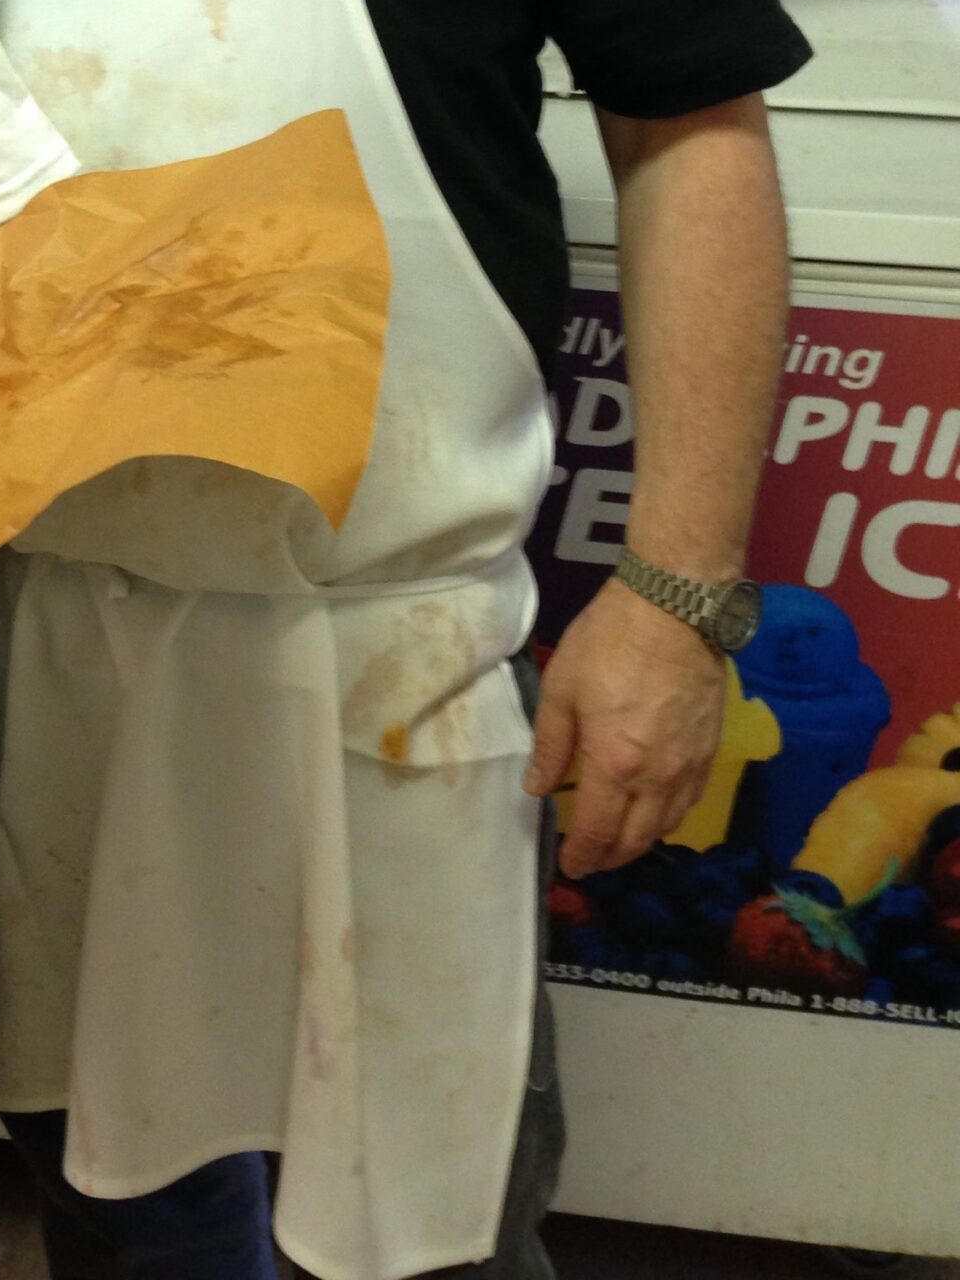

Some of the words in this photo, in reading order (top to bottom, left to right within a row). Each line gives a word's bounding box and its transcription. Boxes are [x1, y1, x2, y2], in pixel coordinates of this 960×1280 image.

[784, 333, 886, 391] ing
[656, 979, 741, 1001] outside
[746, 986, 803, 1007] Phila
